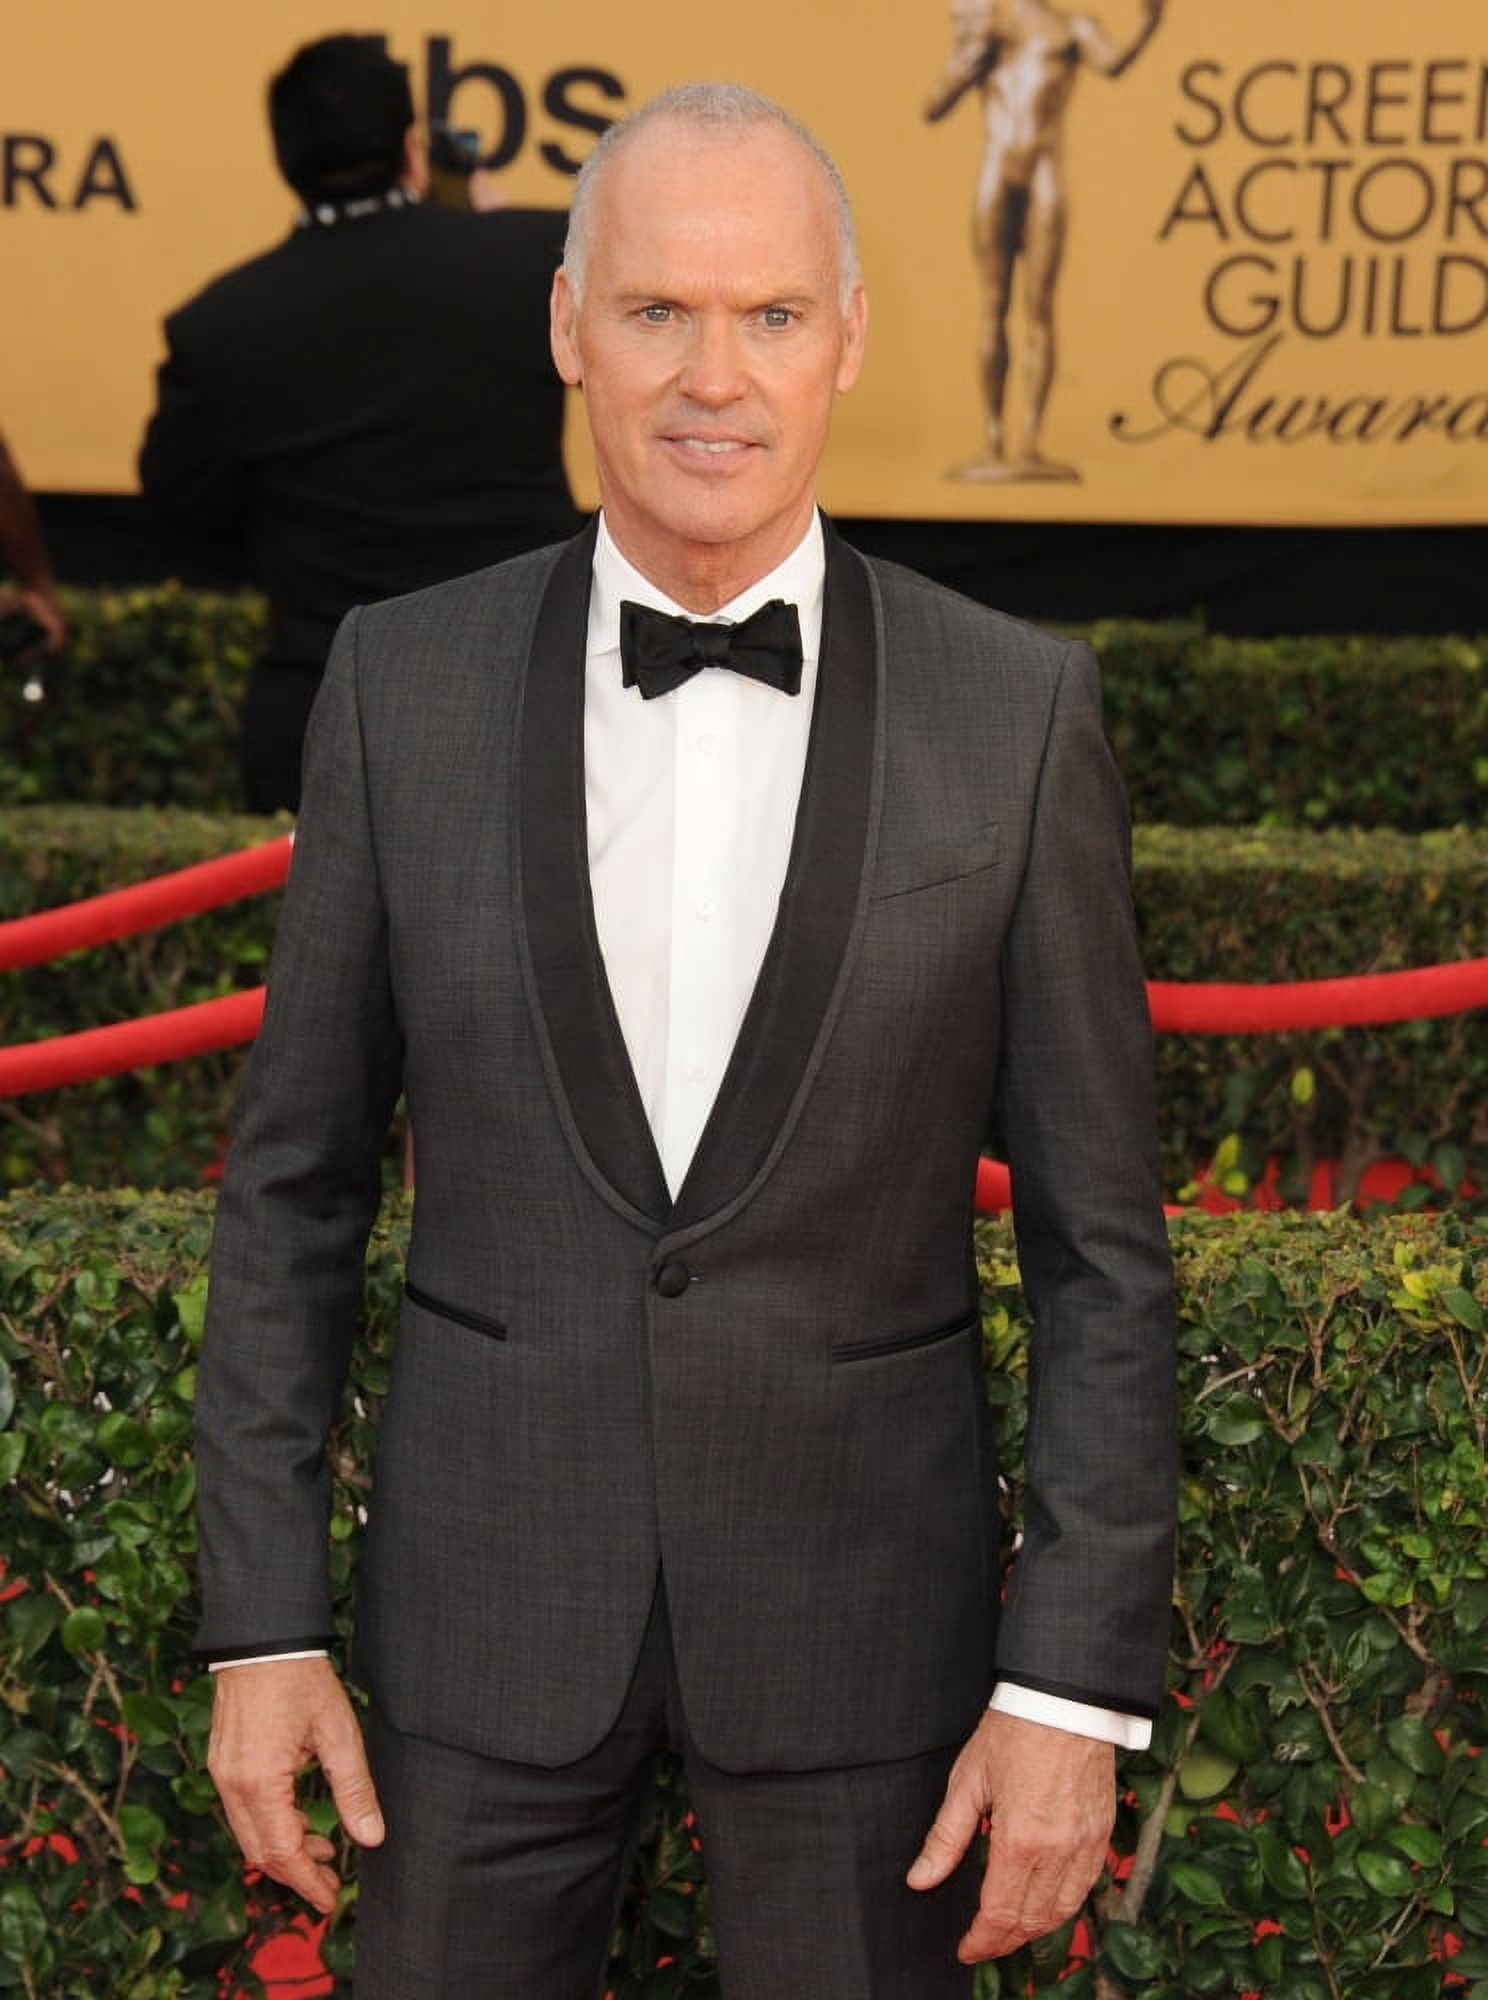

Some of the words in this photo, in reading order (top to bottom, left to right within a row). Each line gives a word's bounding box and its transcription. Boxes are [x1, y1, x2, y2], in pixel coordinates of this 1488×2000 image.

[1174, 59, 1488, 147] SCREE
[2, 134, 137, 212] RA
[1157, 157, 1488, 244] ACTOR
[1202, 252, 1488, 338] GUILD
